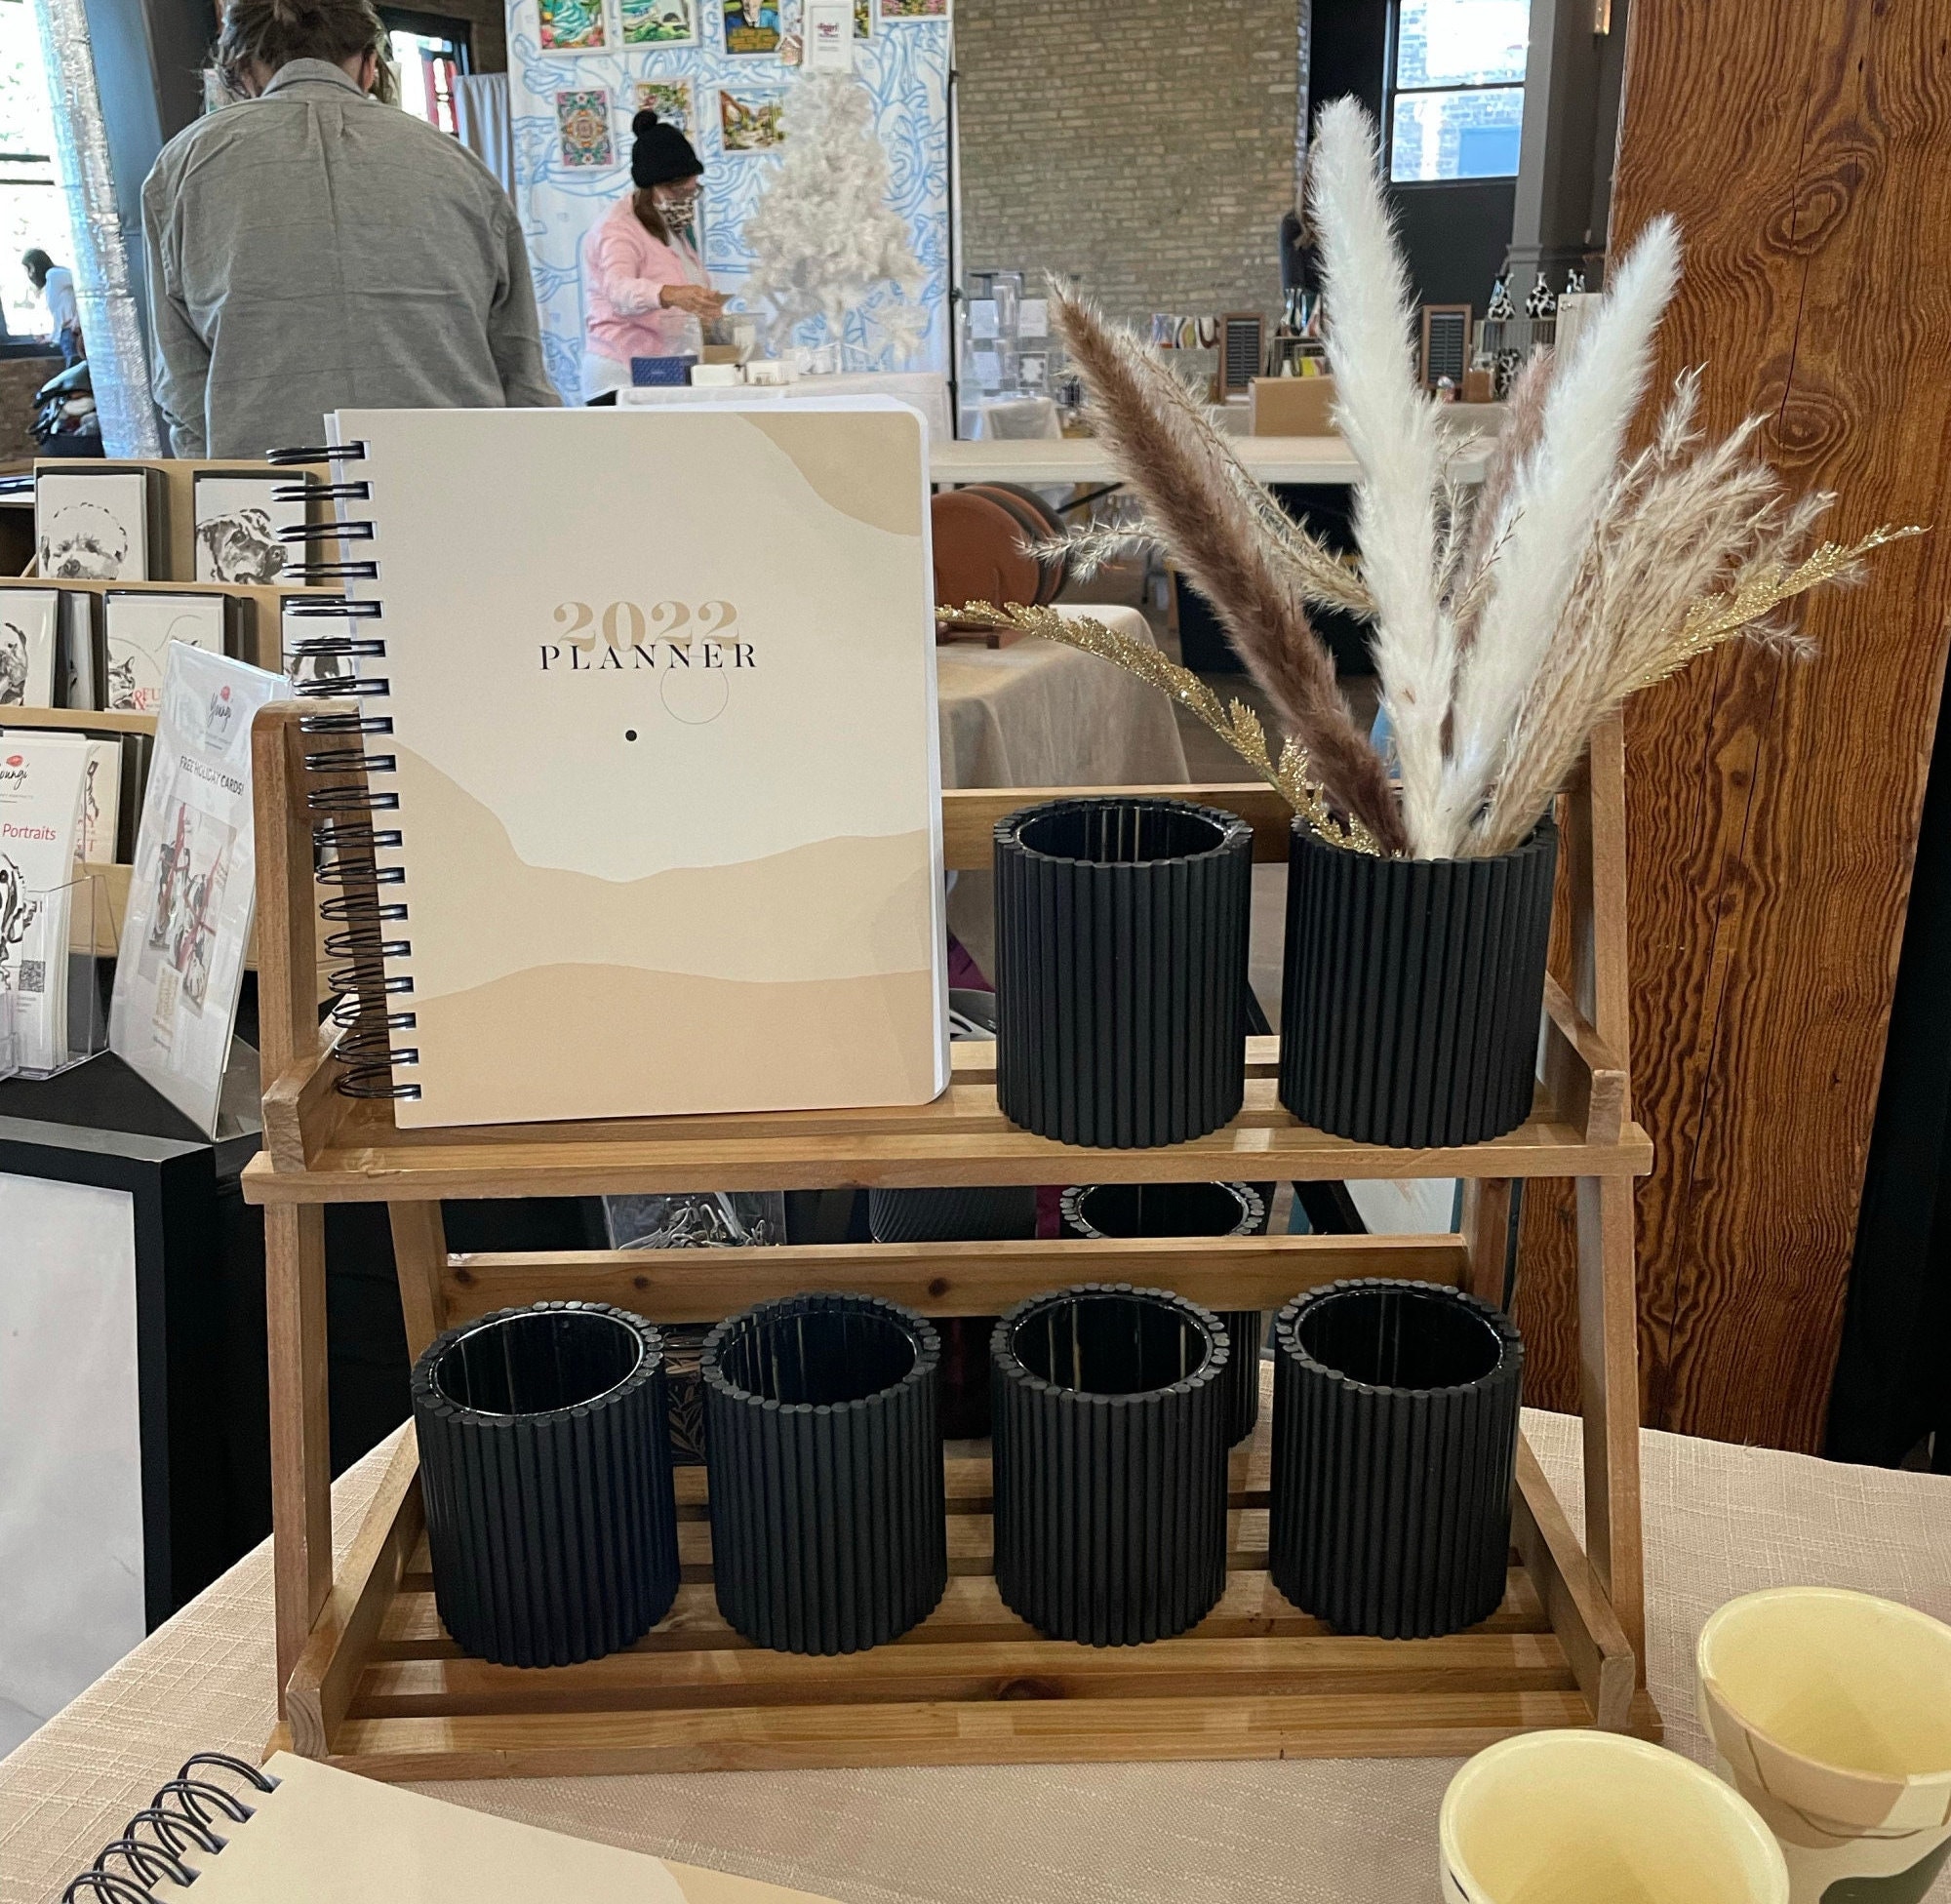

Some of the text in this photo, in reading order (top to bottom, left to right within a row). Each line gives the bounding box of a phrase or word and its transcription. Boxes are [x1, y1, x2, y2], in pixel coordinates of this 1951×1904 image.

[553, 600, 740, 653] 2022
[538, 642, 757, 671] PLANNER
[2, 823, 57, 841] Portraits
